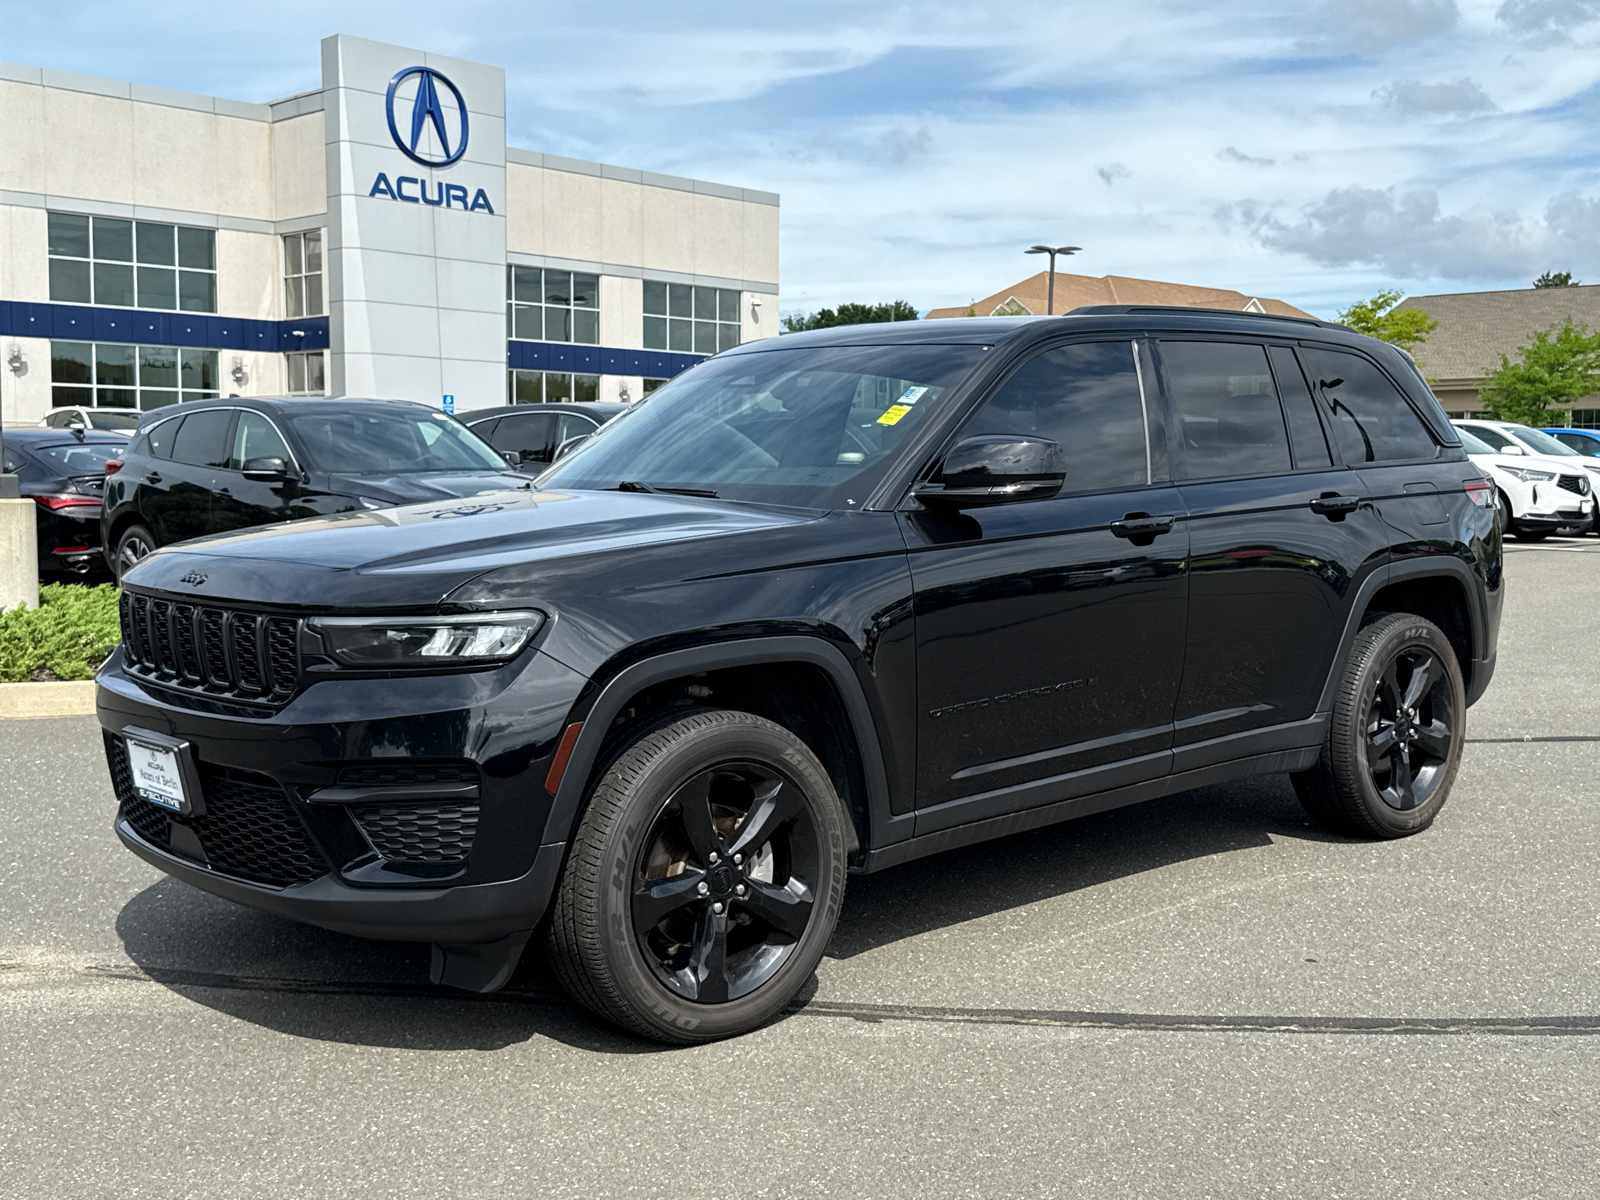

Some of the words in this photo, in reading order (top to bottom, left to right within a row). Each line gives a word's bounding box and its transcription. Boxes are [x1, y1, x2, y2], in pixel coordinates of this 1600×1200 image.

[369, 172, 495, 215] ACURA
[1404, 628, 1431, 642] H/L
[928, 697, 990, 718] GRAND
[994, 679, 1084, 704] CHEROKEE
[147, 761, 165, 772] ACURA
[139, 788, 181, 808] EXECUTIVE
[612, 818, 642, 892] H/L
[782, 749, 843, 925] BRIDGESTONE
[610, 912, 701, 1031] DUELER
